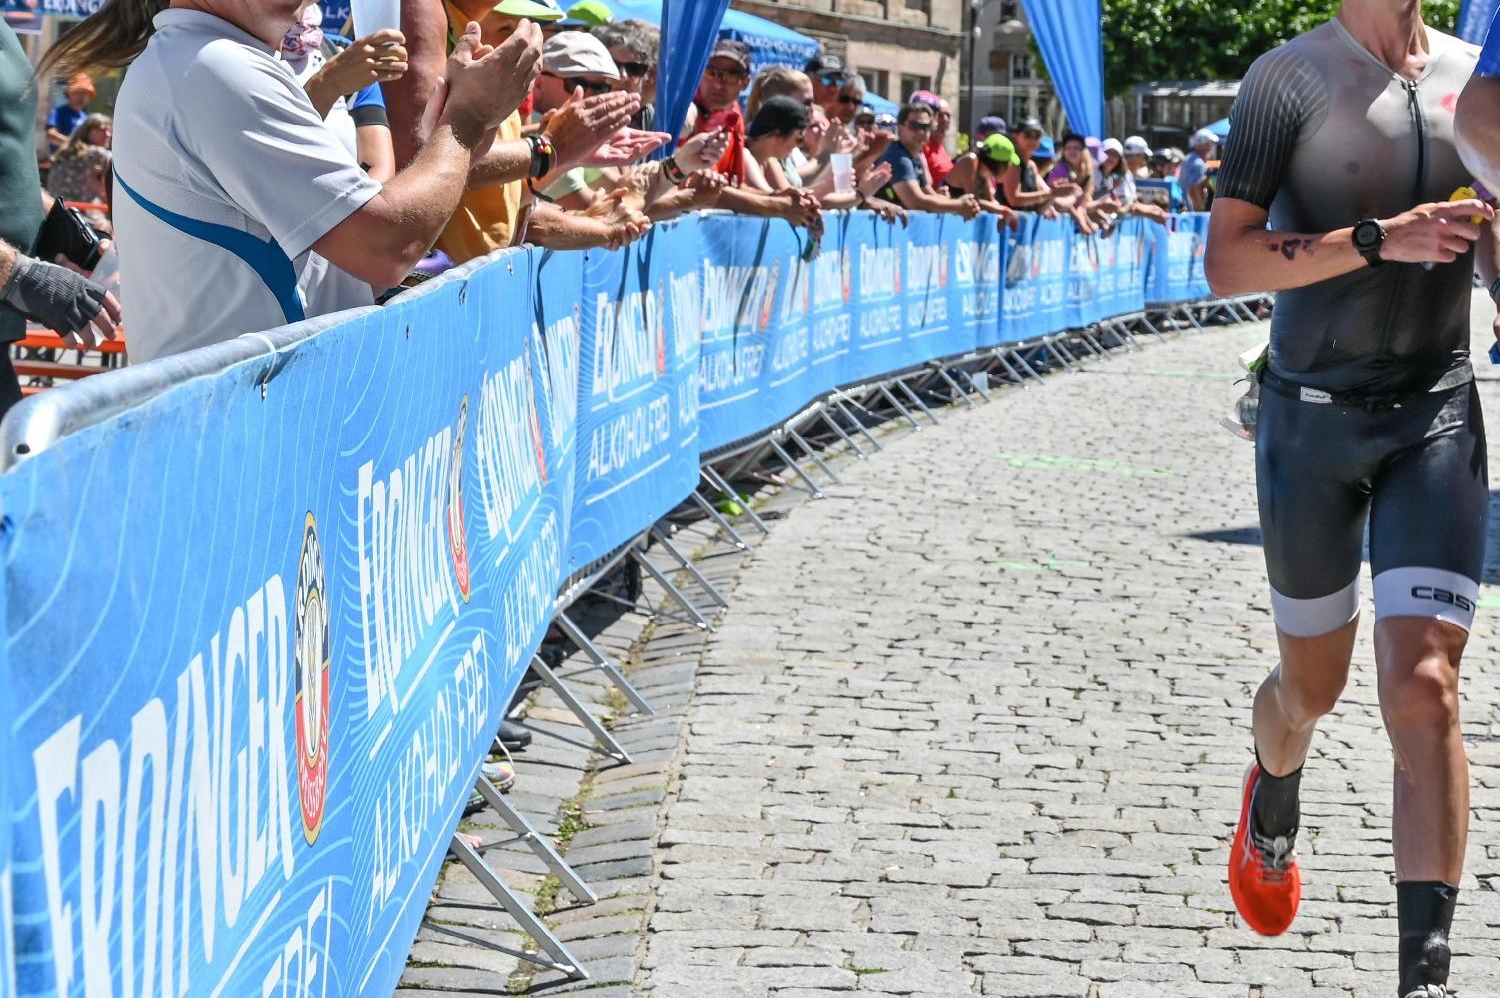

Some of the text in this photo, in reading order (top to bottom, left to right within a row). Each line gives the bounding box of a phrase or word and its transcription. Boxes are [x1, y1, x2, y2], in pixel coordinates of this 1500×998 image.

[358, 425, 459, 721] ERDINGER
[587, 393, 671, 482] ALKOHOLFREI
[34, 573, 295, 998] ERDINGER
[367, 628, 489, 936] ALKOHOLFREI
